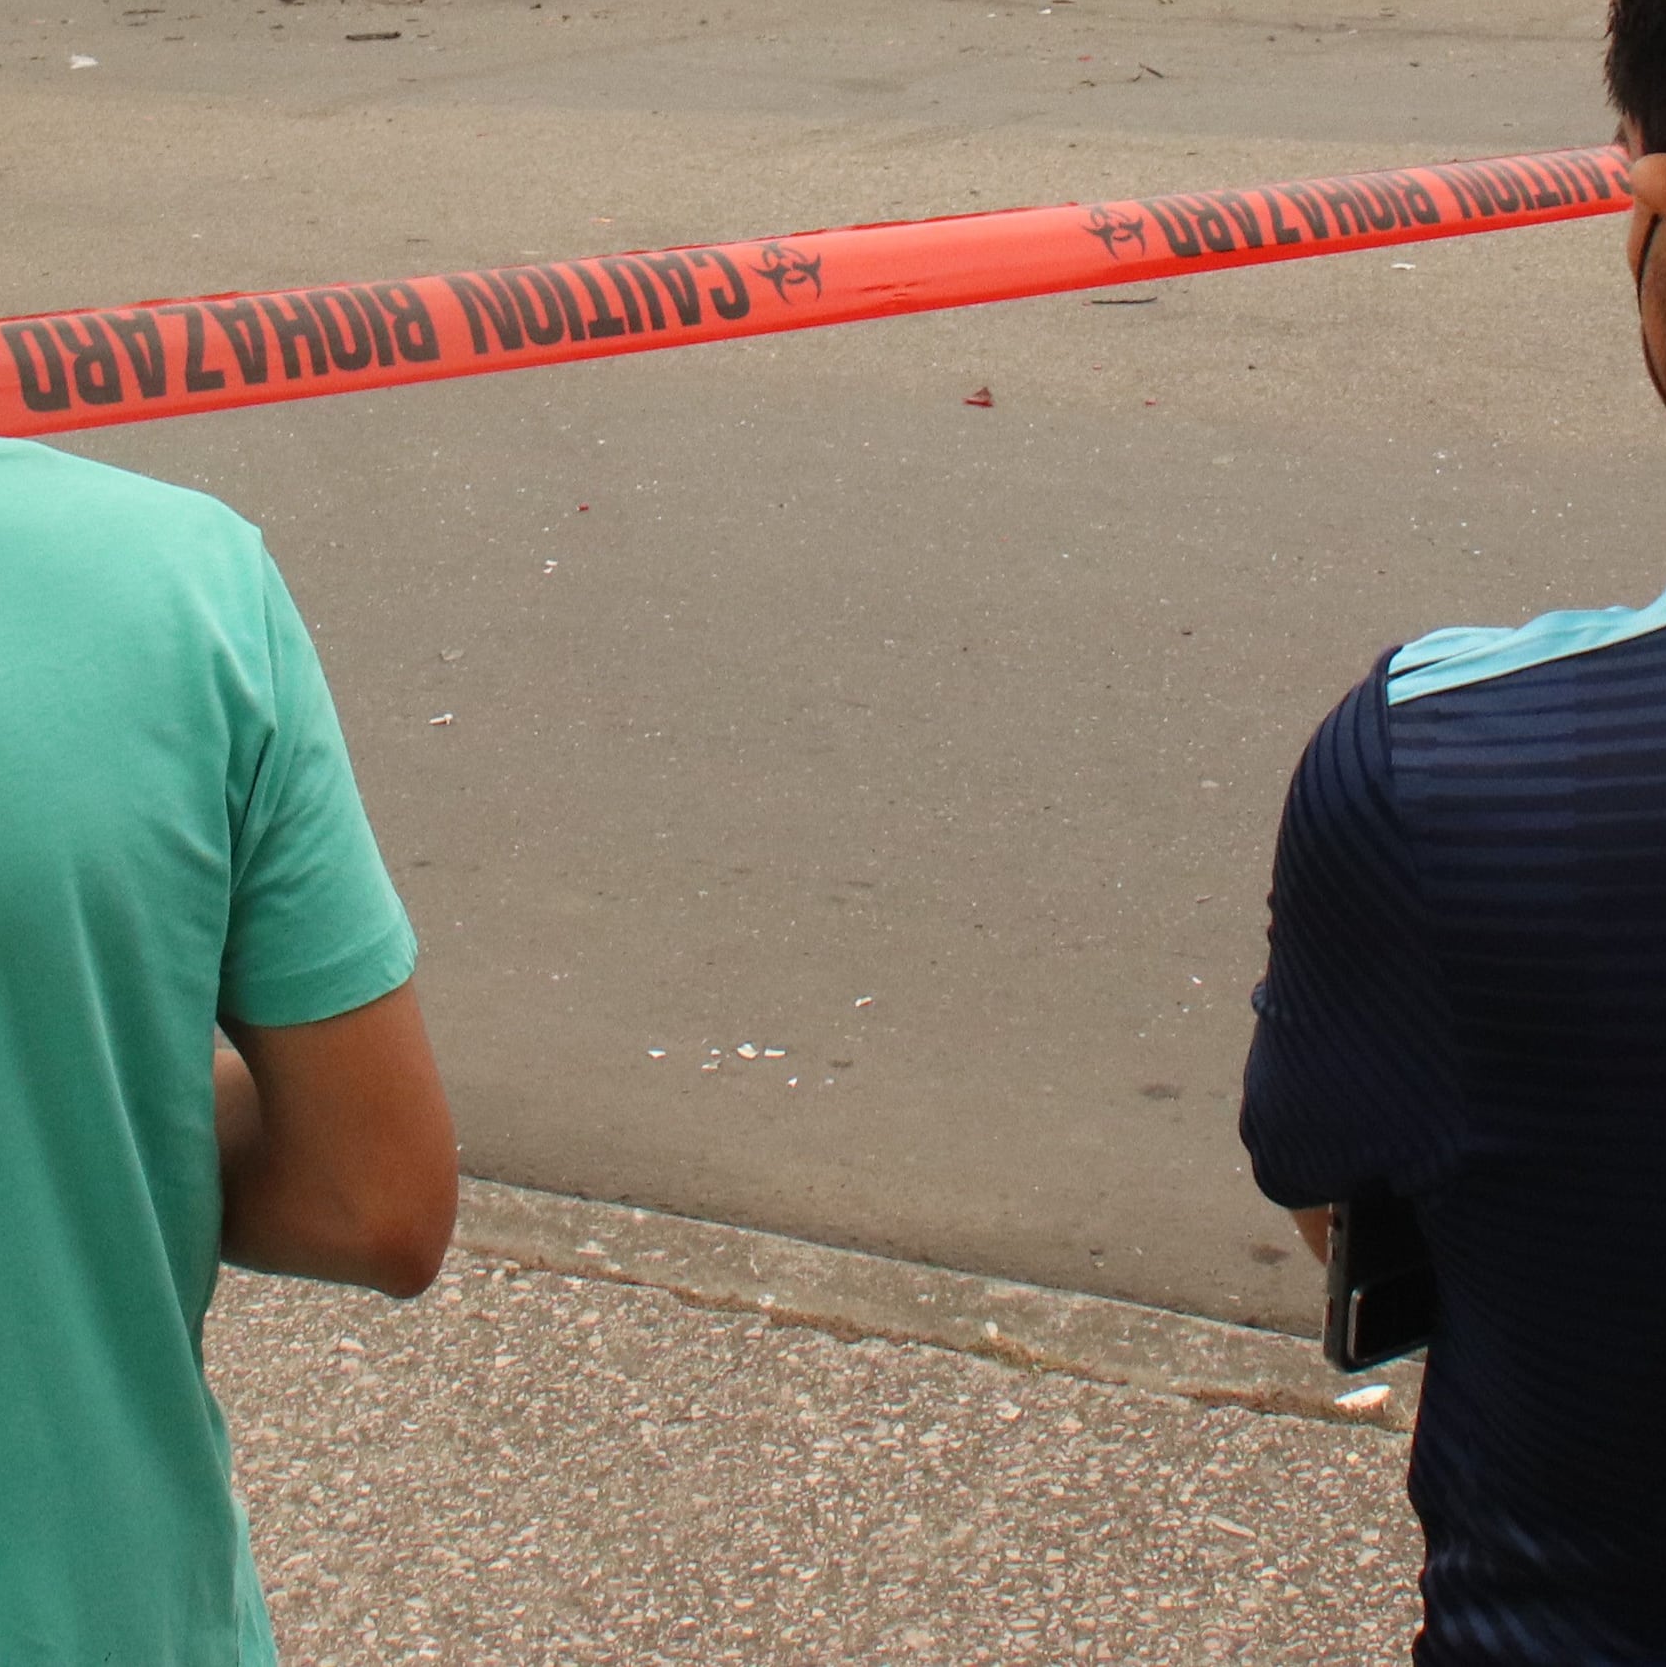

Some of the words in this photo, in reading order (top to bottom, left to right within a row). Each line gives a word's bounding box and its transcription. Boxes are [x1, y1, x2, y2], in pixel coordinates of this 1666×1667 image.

[1139, 166, 1441, 258] BIOHAZARD
[0, 278, 441, 413] BIOHAZARD
[440, 246, 753, 356] CAUTION
